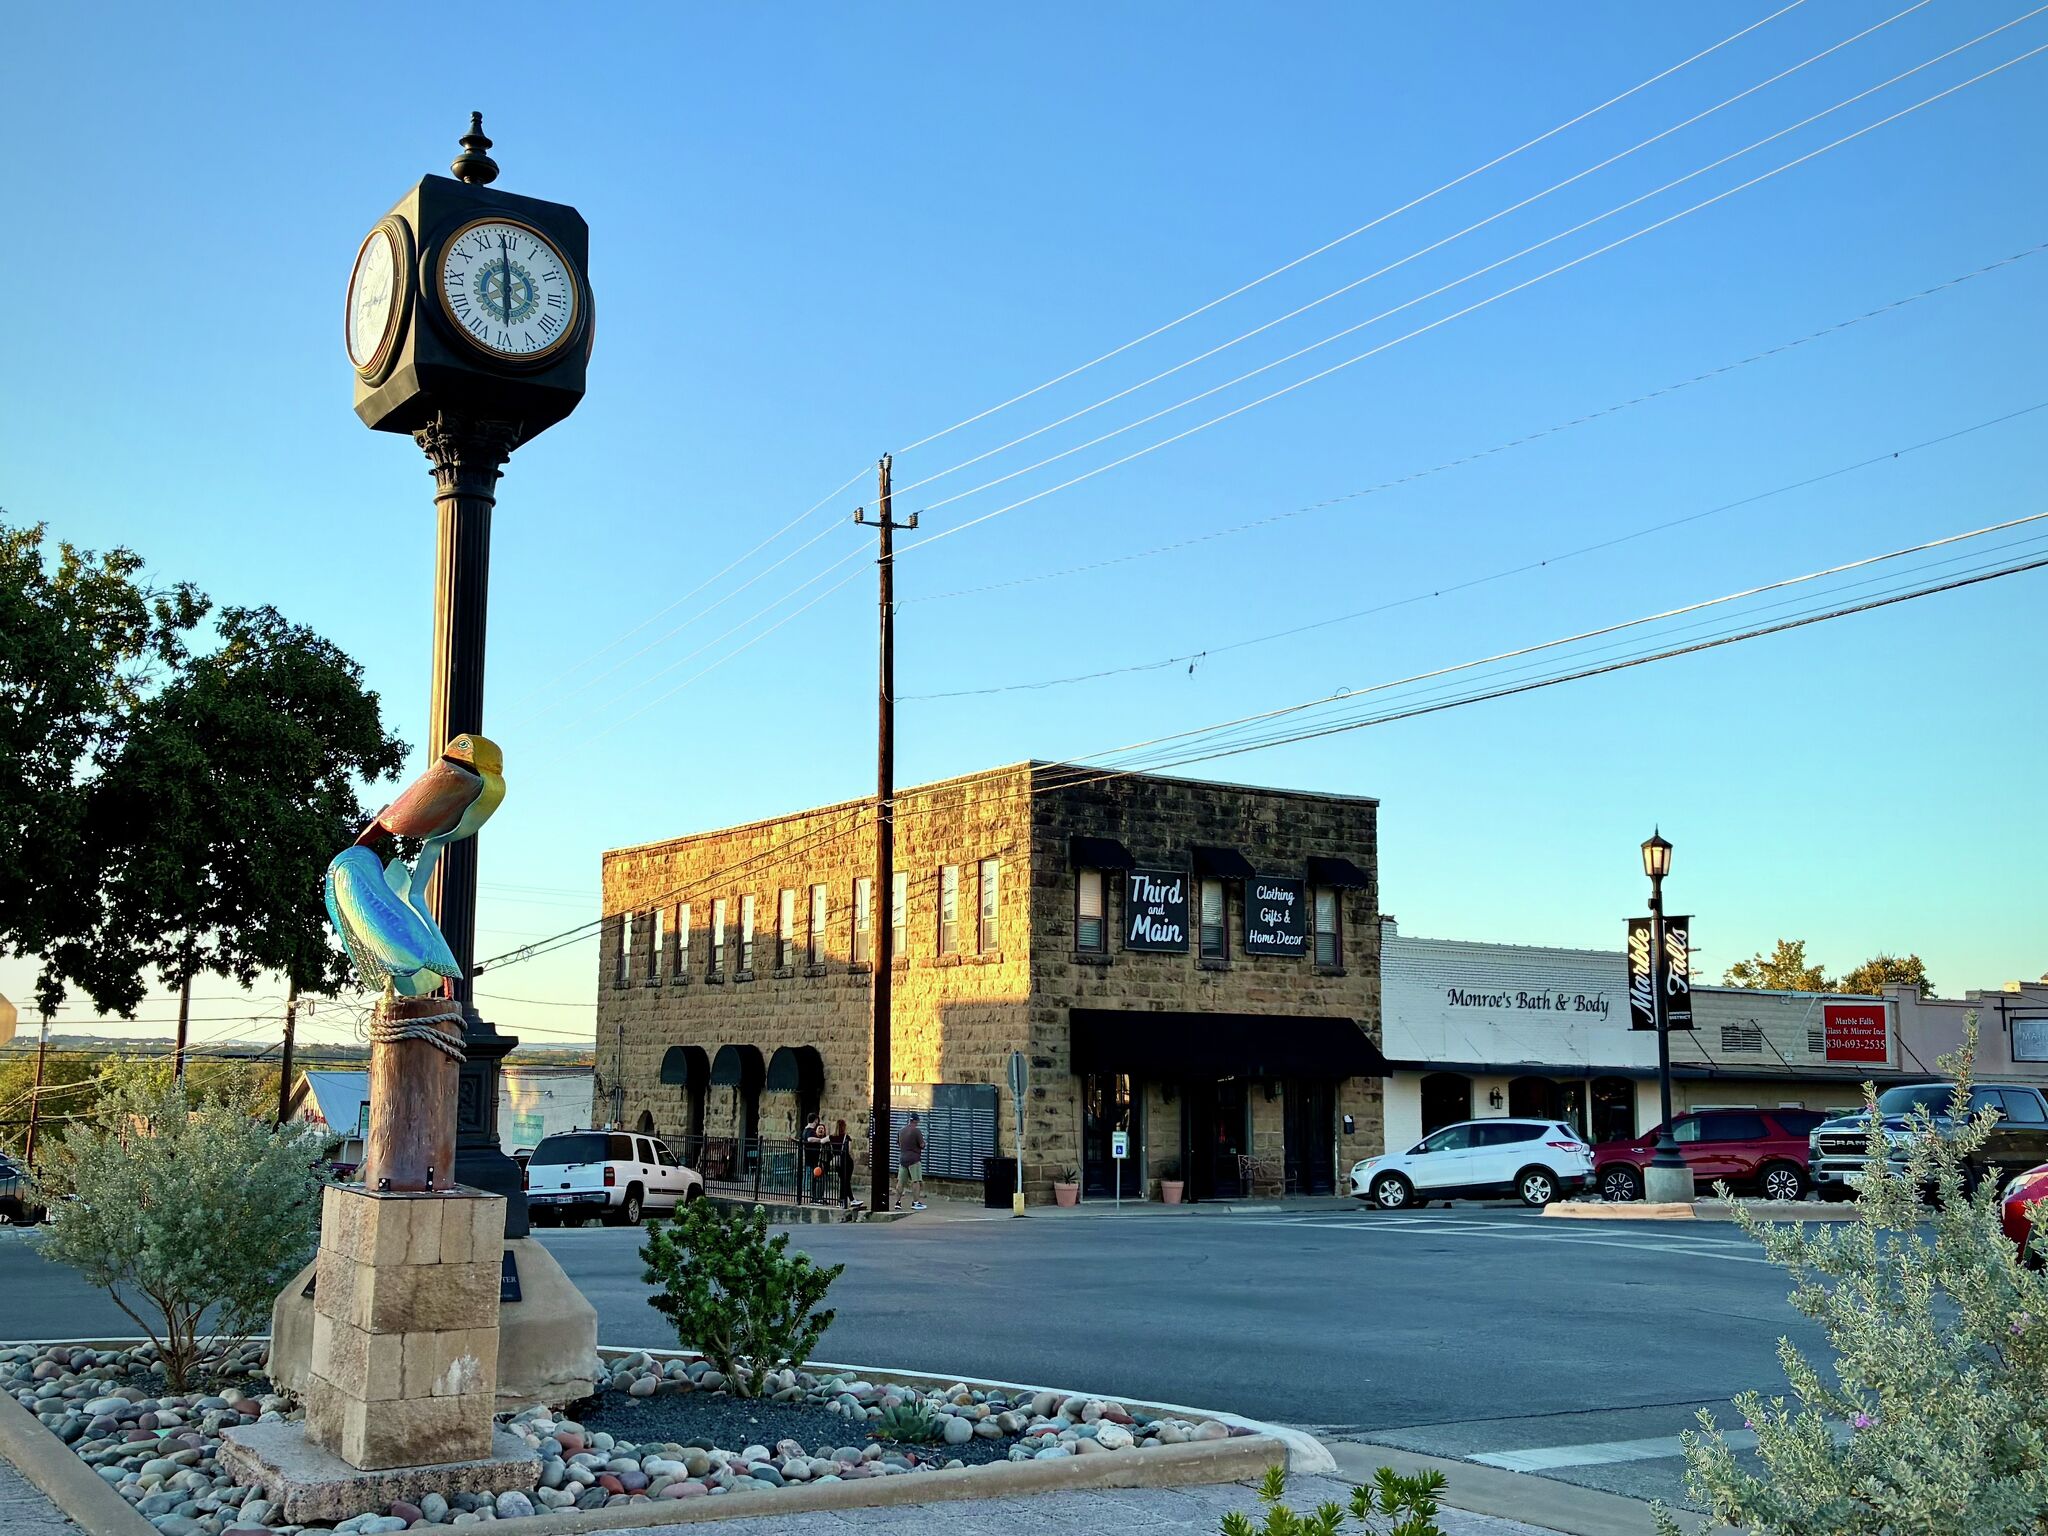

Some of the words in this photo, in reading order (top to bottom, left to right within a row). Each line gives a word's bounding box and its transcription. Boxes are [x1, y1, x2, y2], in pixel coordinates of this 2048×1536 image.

[1130, 875, 1184, 904] Third
[1256, 885, 1295, 906] Clothing
[1147, 903, 1165, 916] and
[1260, 907, 1283, 927] Gifts
[1283, 909, 1291, 924] &
[1130, 914, 1183, 943] Main
[1250, 929, 1276, 945] Home
[1276, 930, 1304, 946] Decor
[1665, 926, 1689, 996] Falls
[1628, 928, 1654, 1024] Marble
[1447, 988, 1512, 1009] Monroe's
[1515, 988, 1552, 1011] Bath
[1555, 993, 1571, 1012] &
[1573, 991, 1609, 1022] Body
[1825, 1027, 1842, 1035] Glass
[1850, 1027, 1872, 1036] Mirror
[1835, 1017, 1858, 1026] Marble
[1859, 1017, 1875, 1026] Falls
[1826, 1038, 1886, 1050] 830-693-2535
